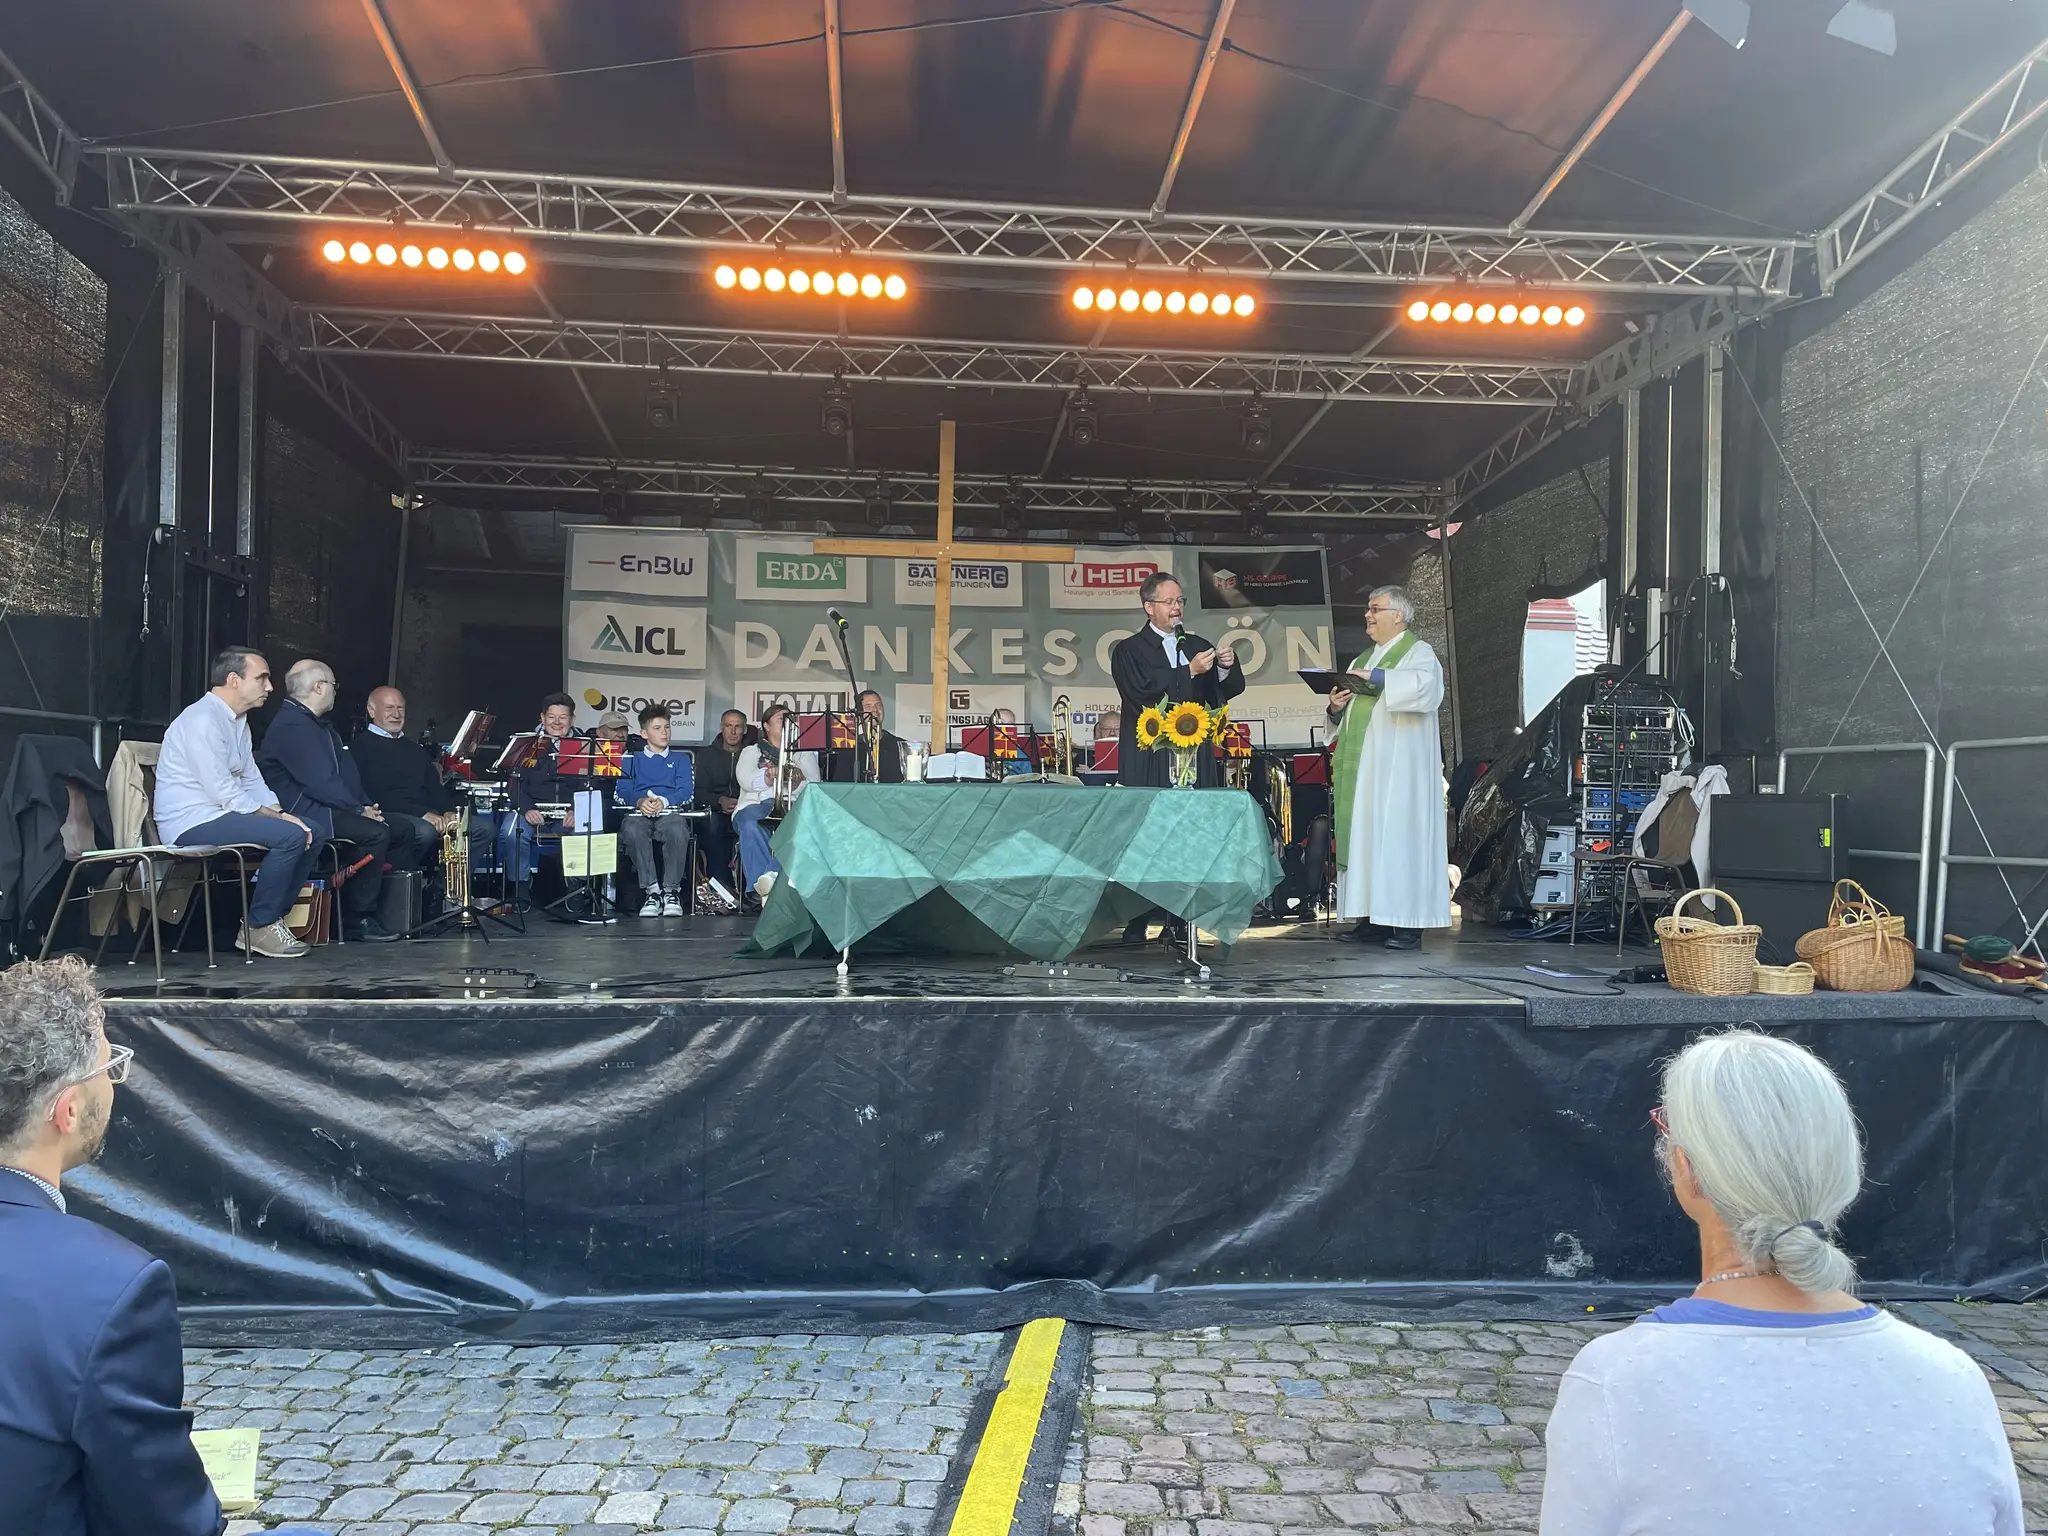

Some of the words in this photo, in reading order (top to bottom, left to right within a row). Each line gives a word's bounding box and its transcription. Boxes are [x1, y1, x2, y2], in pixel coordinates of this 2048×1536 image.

[620, 555, 693, 575] EnBW
[765, 561, 838, 581] ERDA
[908, 579, 991, 589] DIENSTSTUNGEN
[1087, 567, 1154, 584] HEID
[635, 626, 686, 655] ICL
[735, 615, 1332, 677] DANKESCÖN
[1085, 704, 1121, 712] HOLZBA
